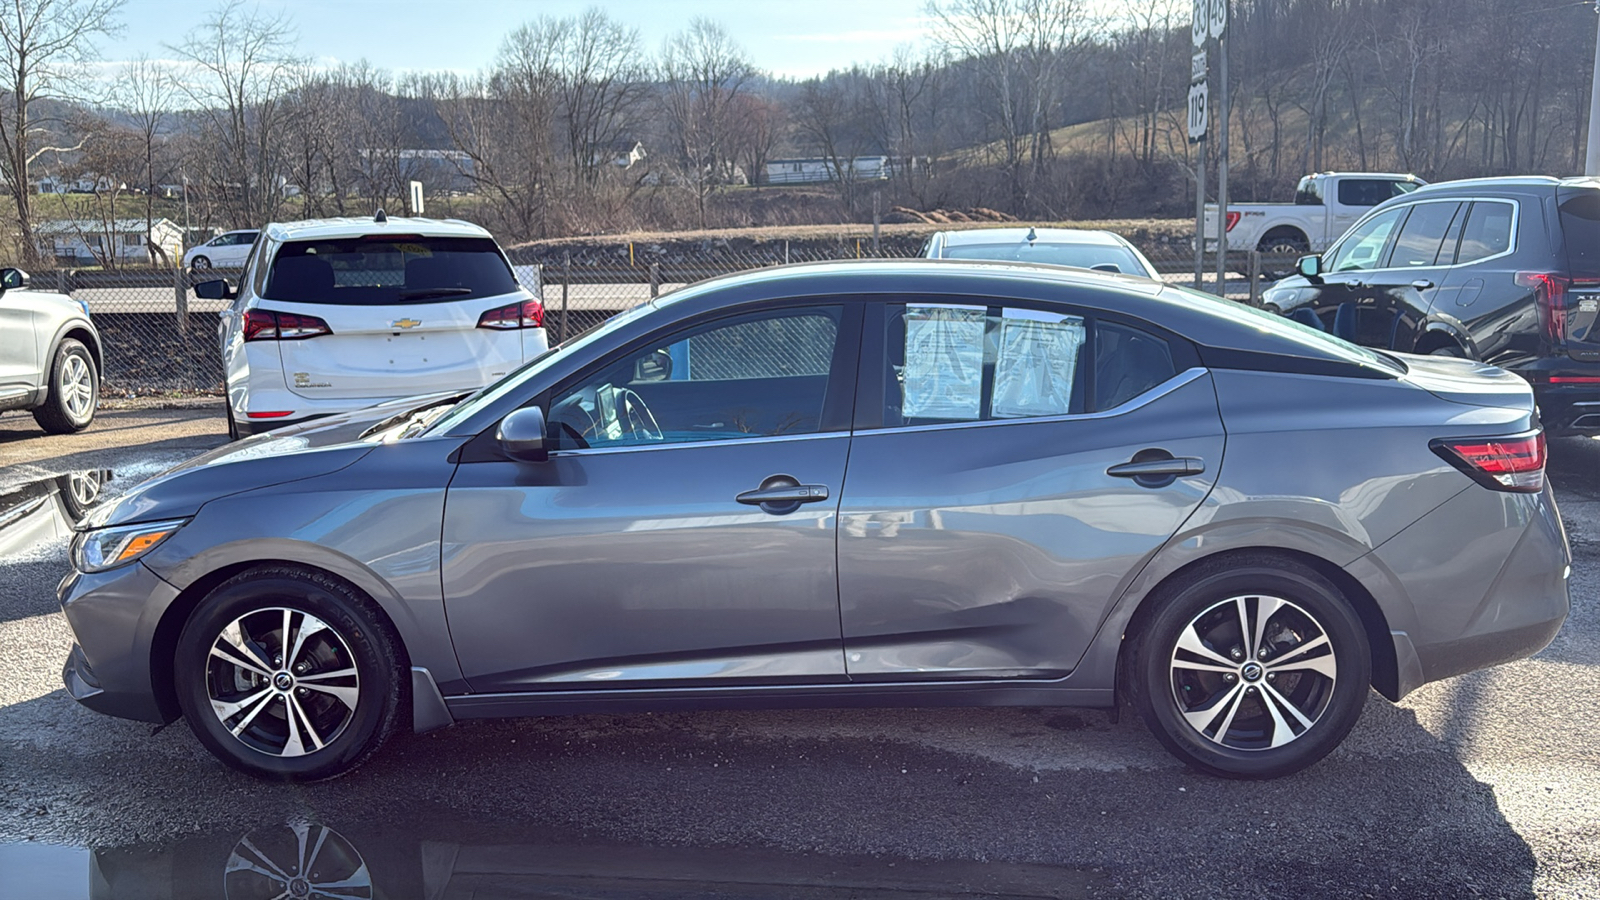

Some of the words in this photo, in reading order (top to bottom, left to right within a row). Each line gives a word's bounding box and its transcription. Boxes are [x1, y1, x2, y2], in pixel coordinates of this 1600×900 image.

[1194, 0, 1206, 37] 33
[1210, 0, 1225, 26] 48
[1191, 94, 1204, 128] 119
